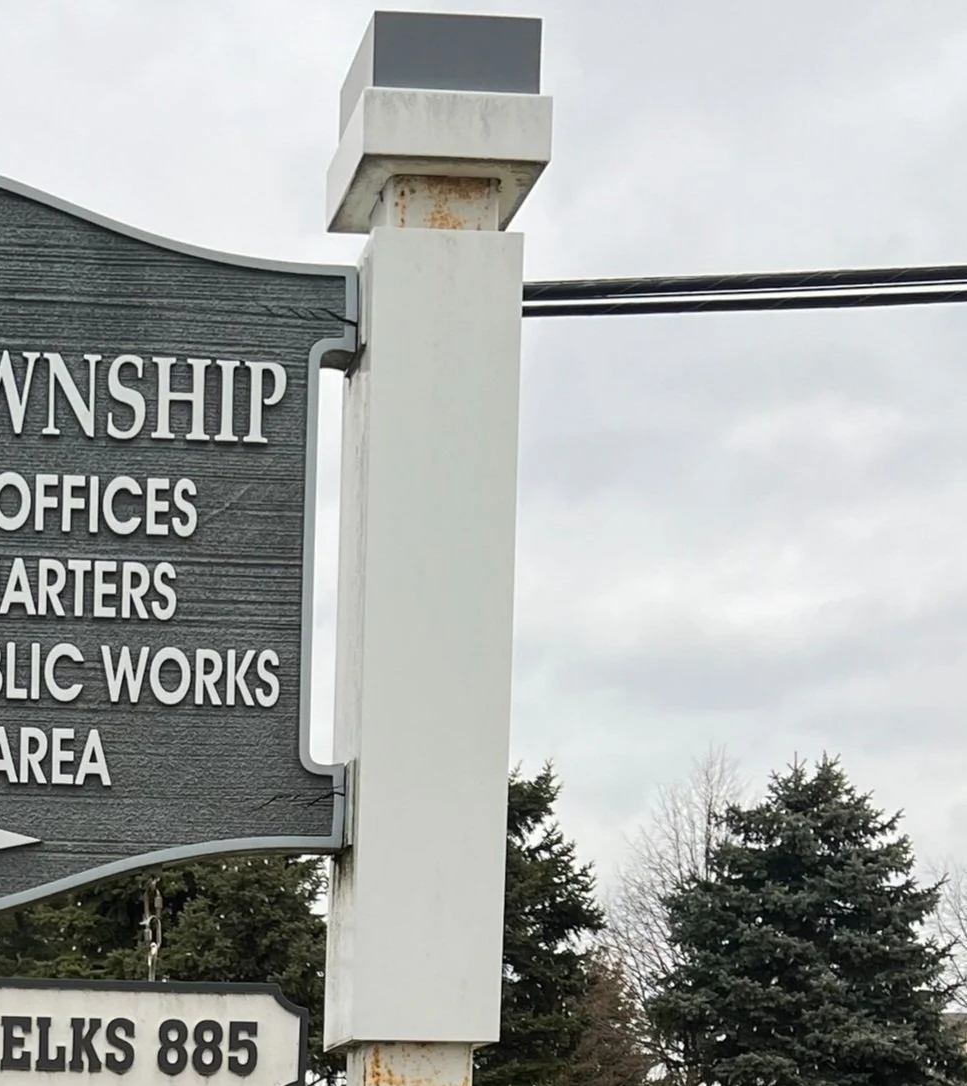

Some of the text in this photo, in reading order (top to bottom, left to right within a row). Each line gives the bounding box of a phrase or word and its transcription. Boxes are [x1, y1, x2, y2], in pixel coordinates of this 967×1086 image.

[100, 644, 281, 708] WORKS
[0, 1015, 136, 1076] ELKS
[157, 1018, 258, 1078] 885
